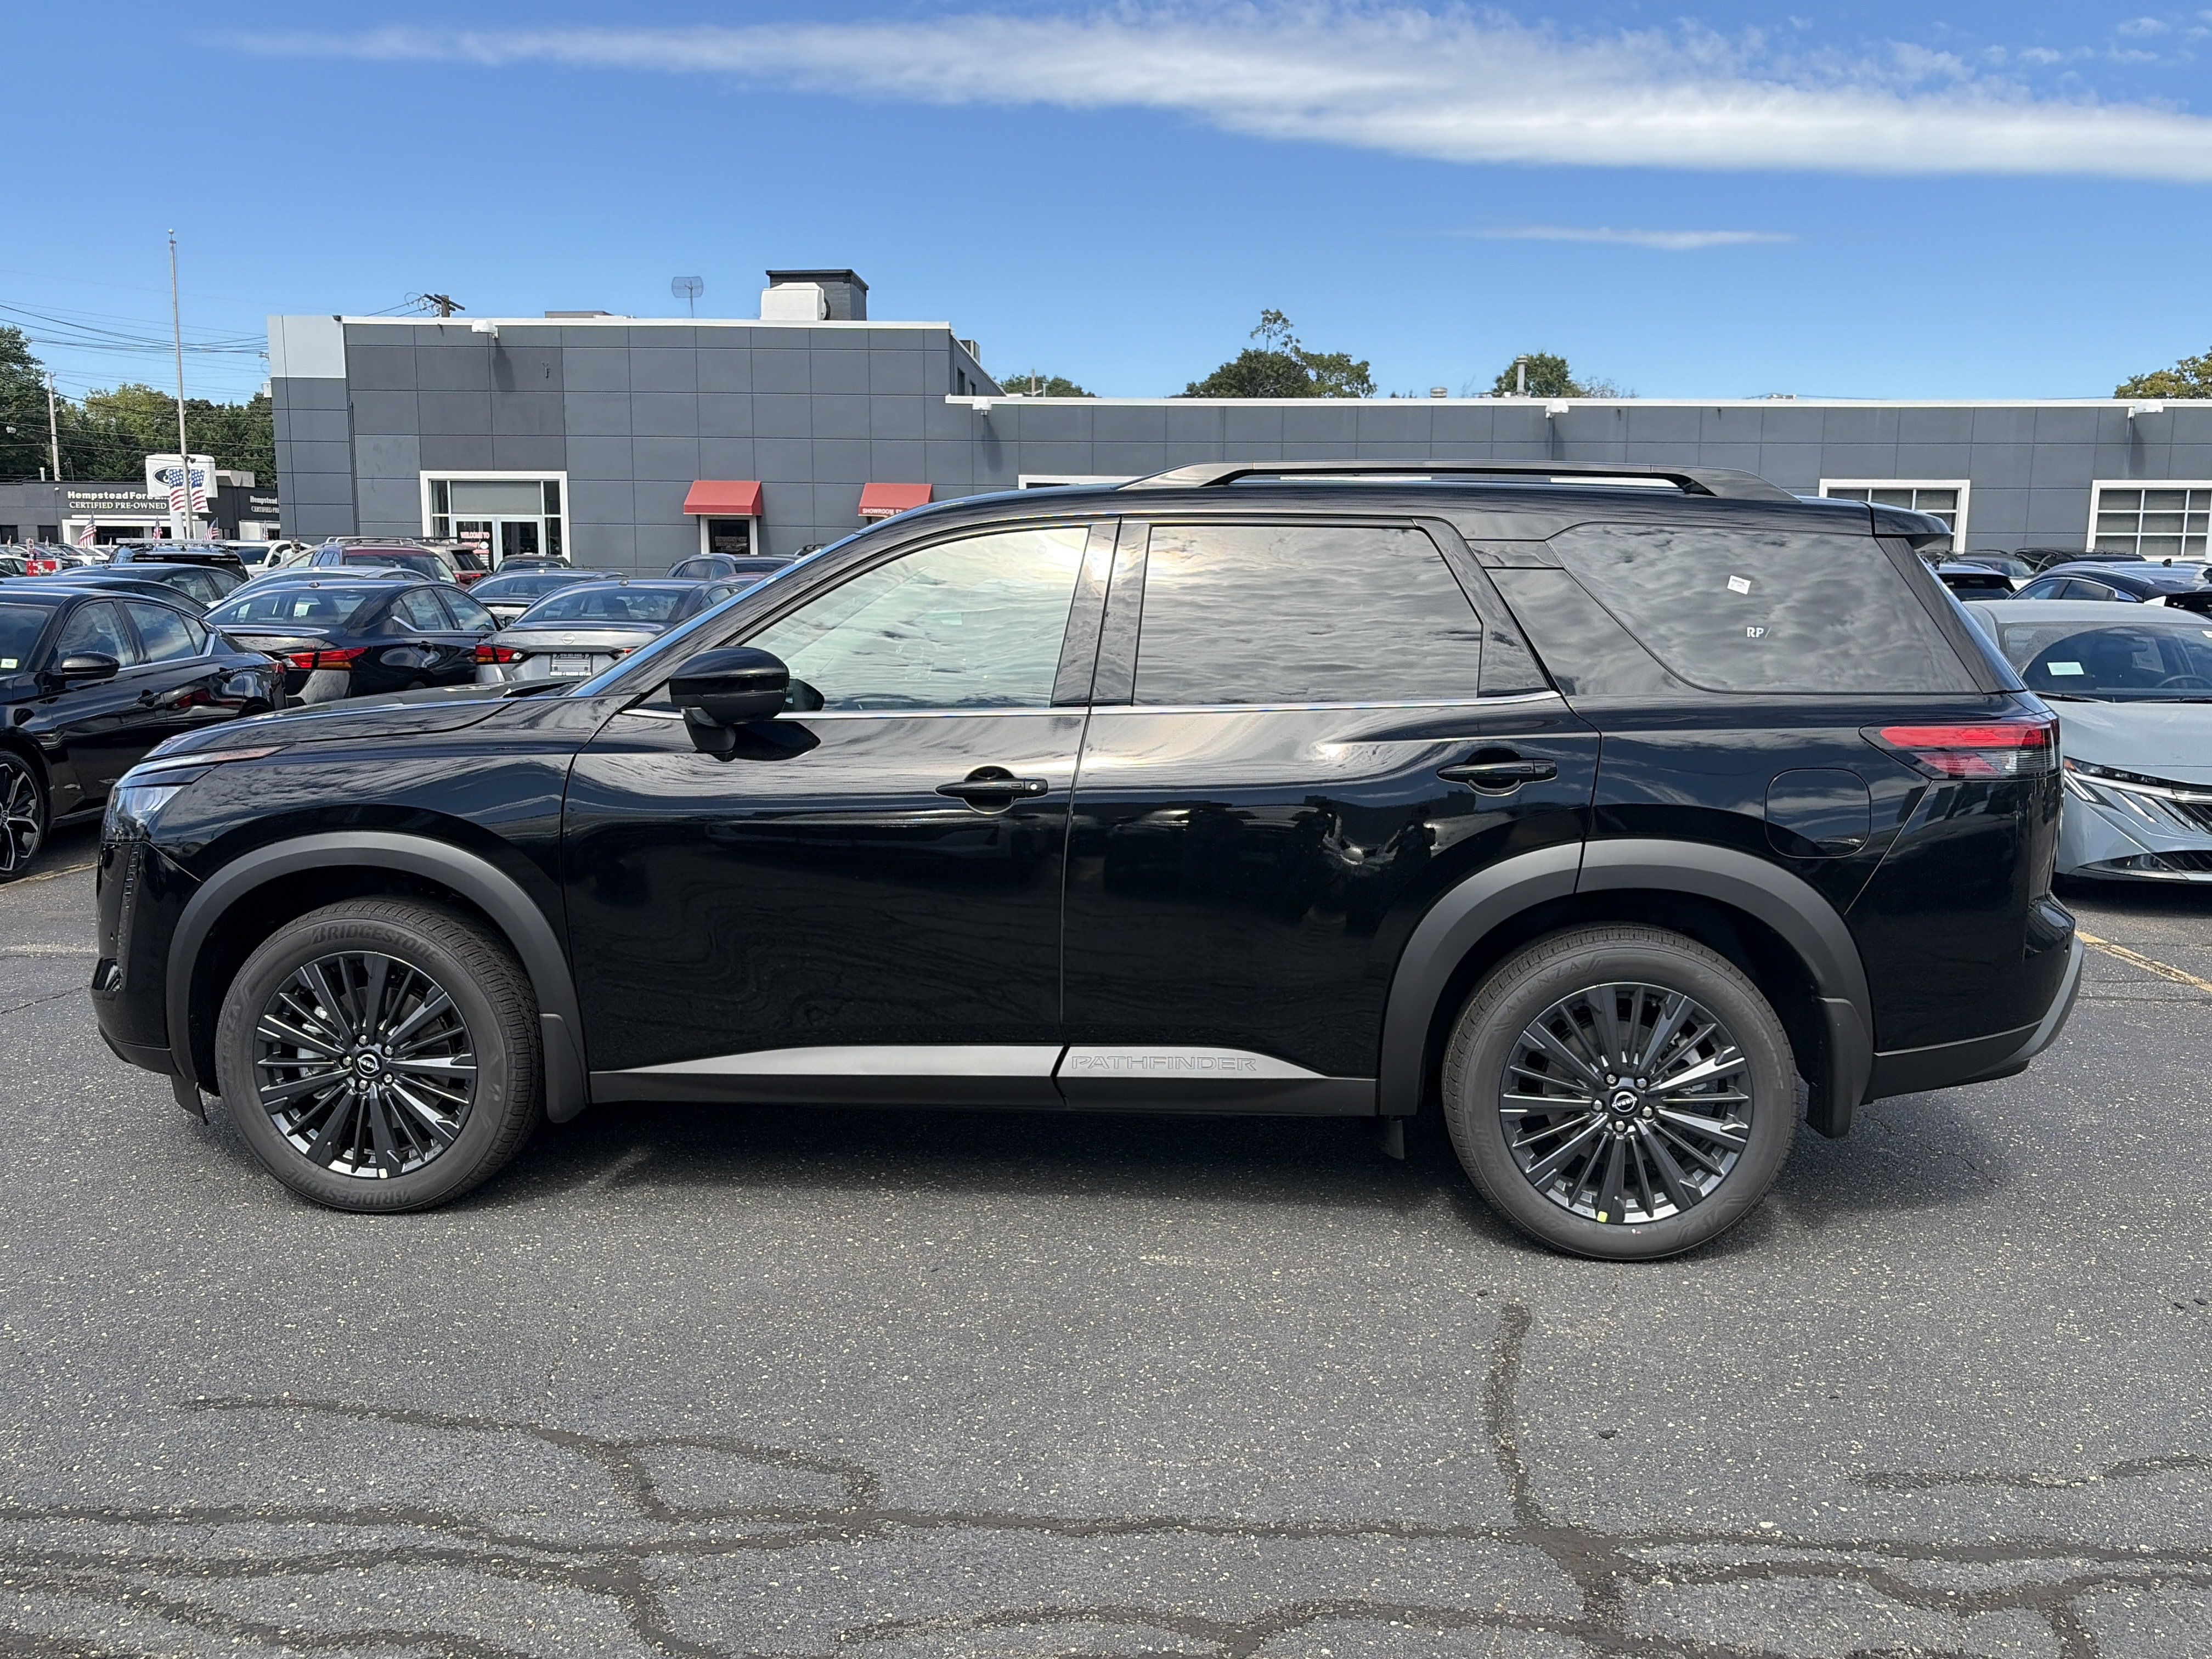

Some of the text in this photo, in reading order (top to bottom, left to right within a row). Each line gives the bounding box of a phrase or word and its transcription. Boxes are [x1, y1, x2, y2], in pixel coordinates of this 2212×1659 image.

[67, 491, 128, 501] Hempstead
[312, 924, 439, 964] BRIDGESTONE
[357, 1057, 380, 1071] NISSAN
[1071, 1056, 1257, 1071] PATHFINDER
